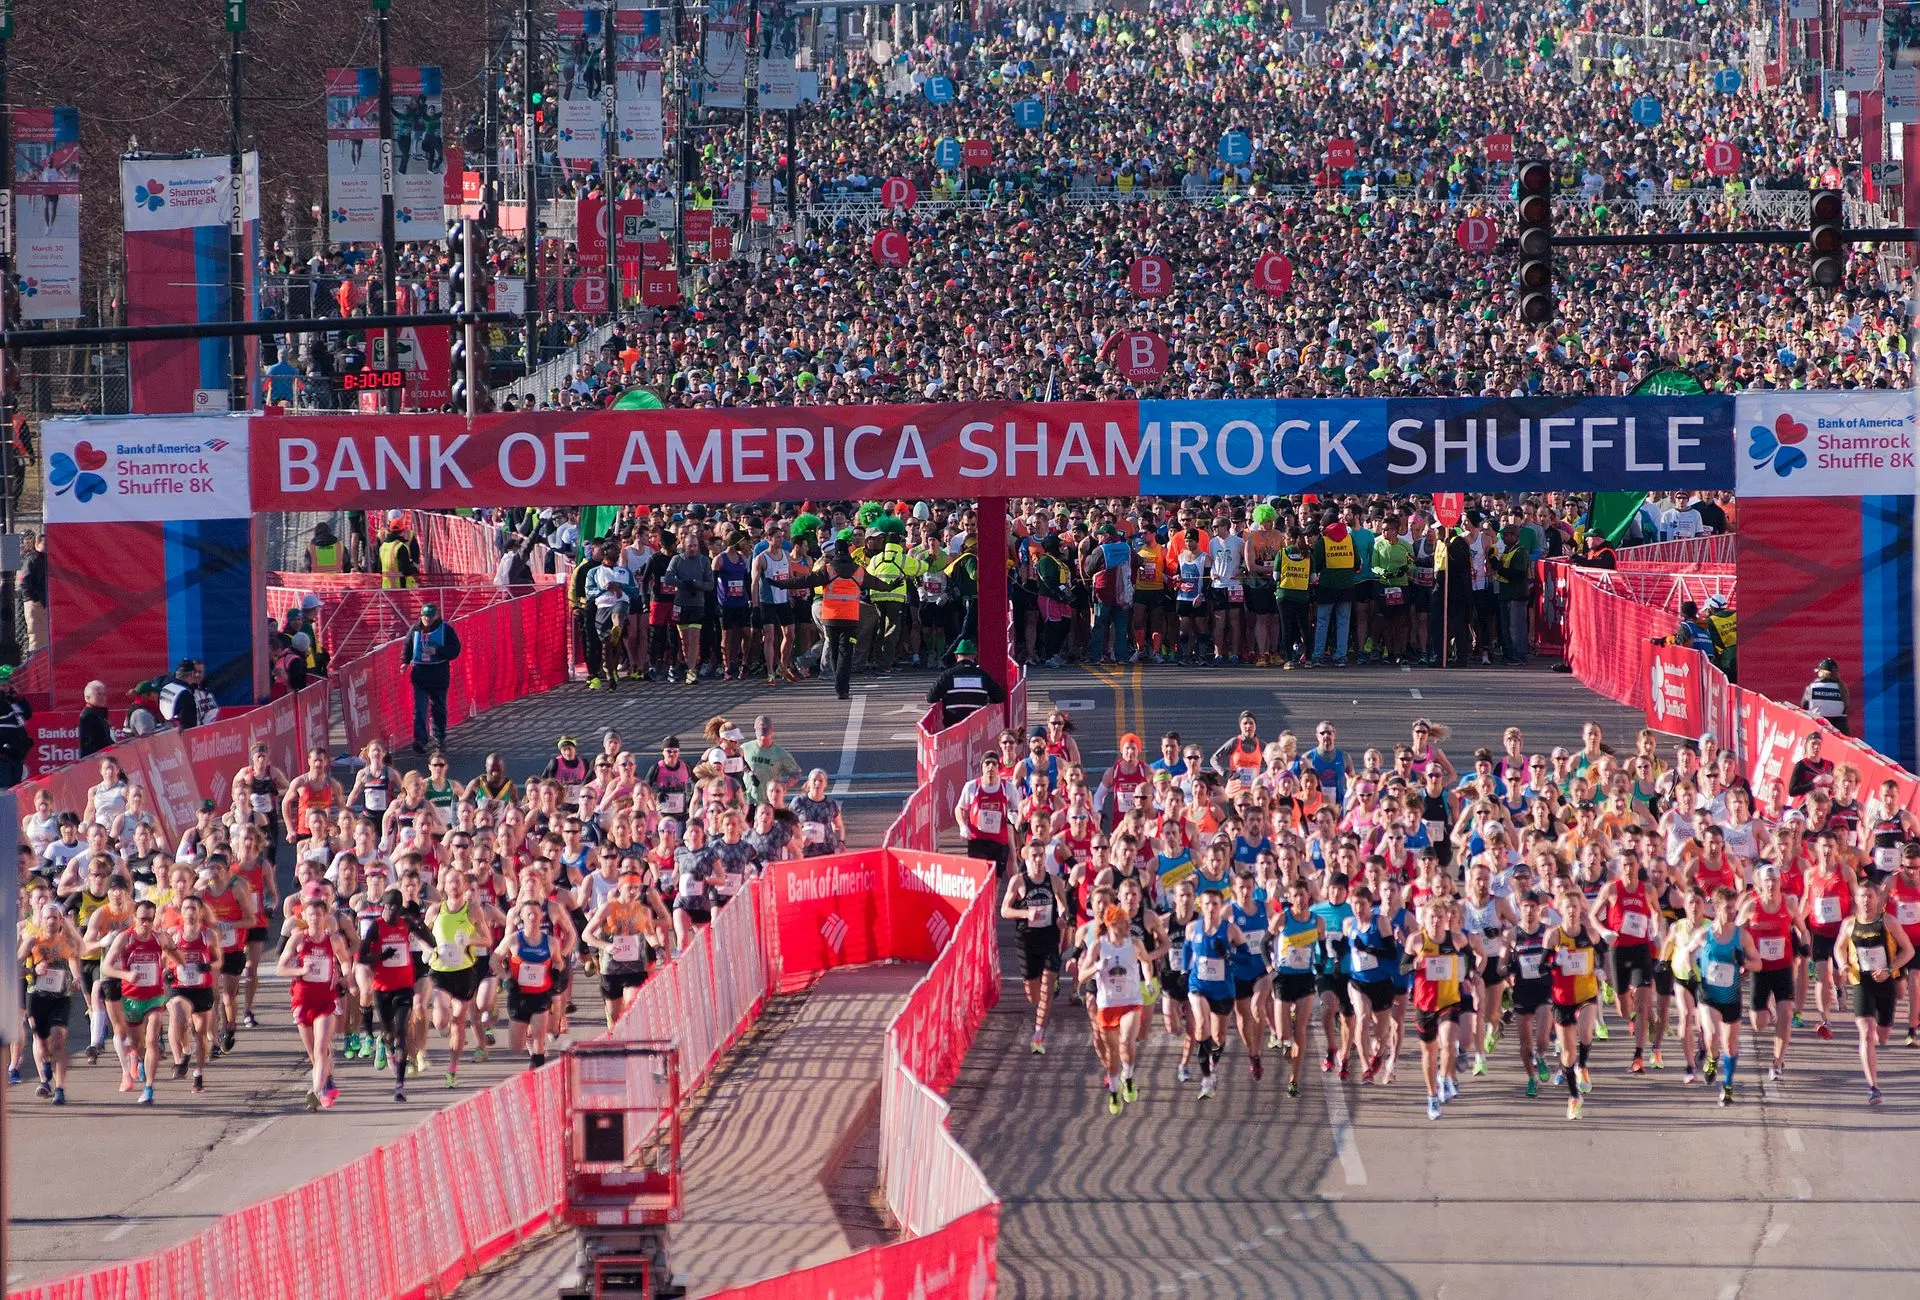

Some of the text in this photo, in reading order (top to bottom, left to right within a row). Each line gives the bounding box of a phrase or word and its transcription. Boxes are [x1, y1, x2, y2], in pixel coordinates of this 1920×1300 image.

[849, 16, 863, 36] L
[877, 46, 886, 58] L
[932, 77, 946, 96] E
[1723, 70, 1733, 88] F
[1024, 102, 1036, 120] F
[1641, 98, 1654, 120] F
[943, 140, 954, 162] E
[1228, 134, 1244, 156] E
[1714, 144, 1732, 166] D
[169, 186, 216, 197] Shamrock
[889, 180, 907, 202] D
[169, 196, 218, 207] Shuffle 8K
[231, 177, 241, 232] C121
[1469, 219, 1489, 244] D
[882, 232, 898, 258] C
[1141, 260, 1161, 287] B
[1264, 256, 1282, 284] C
[585, 277, 605, 303] B
[649, 283, 672, 292] EE 1
[1131, 336, 1155, 368] B
[1129, 367, 1159, 376] CORRAL
[1818, 417, 1904, 429] Bank of America
[116, 443, 201, 455] Bank of America
[1818, 433, 1910, 450] Shamrock
[279, 416, 1706, 493] BANK OF AMERICA SHAMROCK SHUFFLE
[1818, 452, 1915, 469] Shuffle 8K
[117, 459, 209, 476] Shamrock
[118, 477, 215, 495] Shuffle 8K
[1442, 492, 1457, 509] A
[1282, 571, 1308, 579] CORRALS
[38, 727, 79, 739] Bank of
[191, 736, 209, 763] Bank
[215, 728, 242, 756] America
[787, 863, 877, 902] Bank of America
[898, 859, 976, 900] Bank of America
